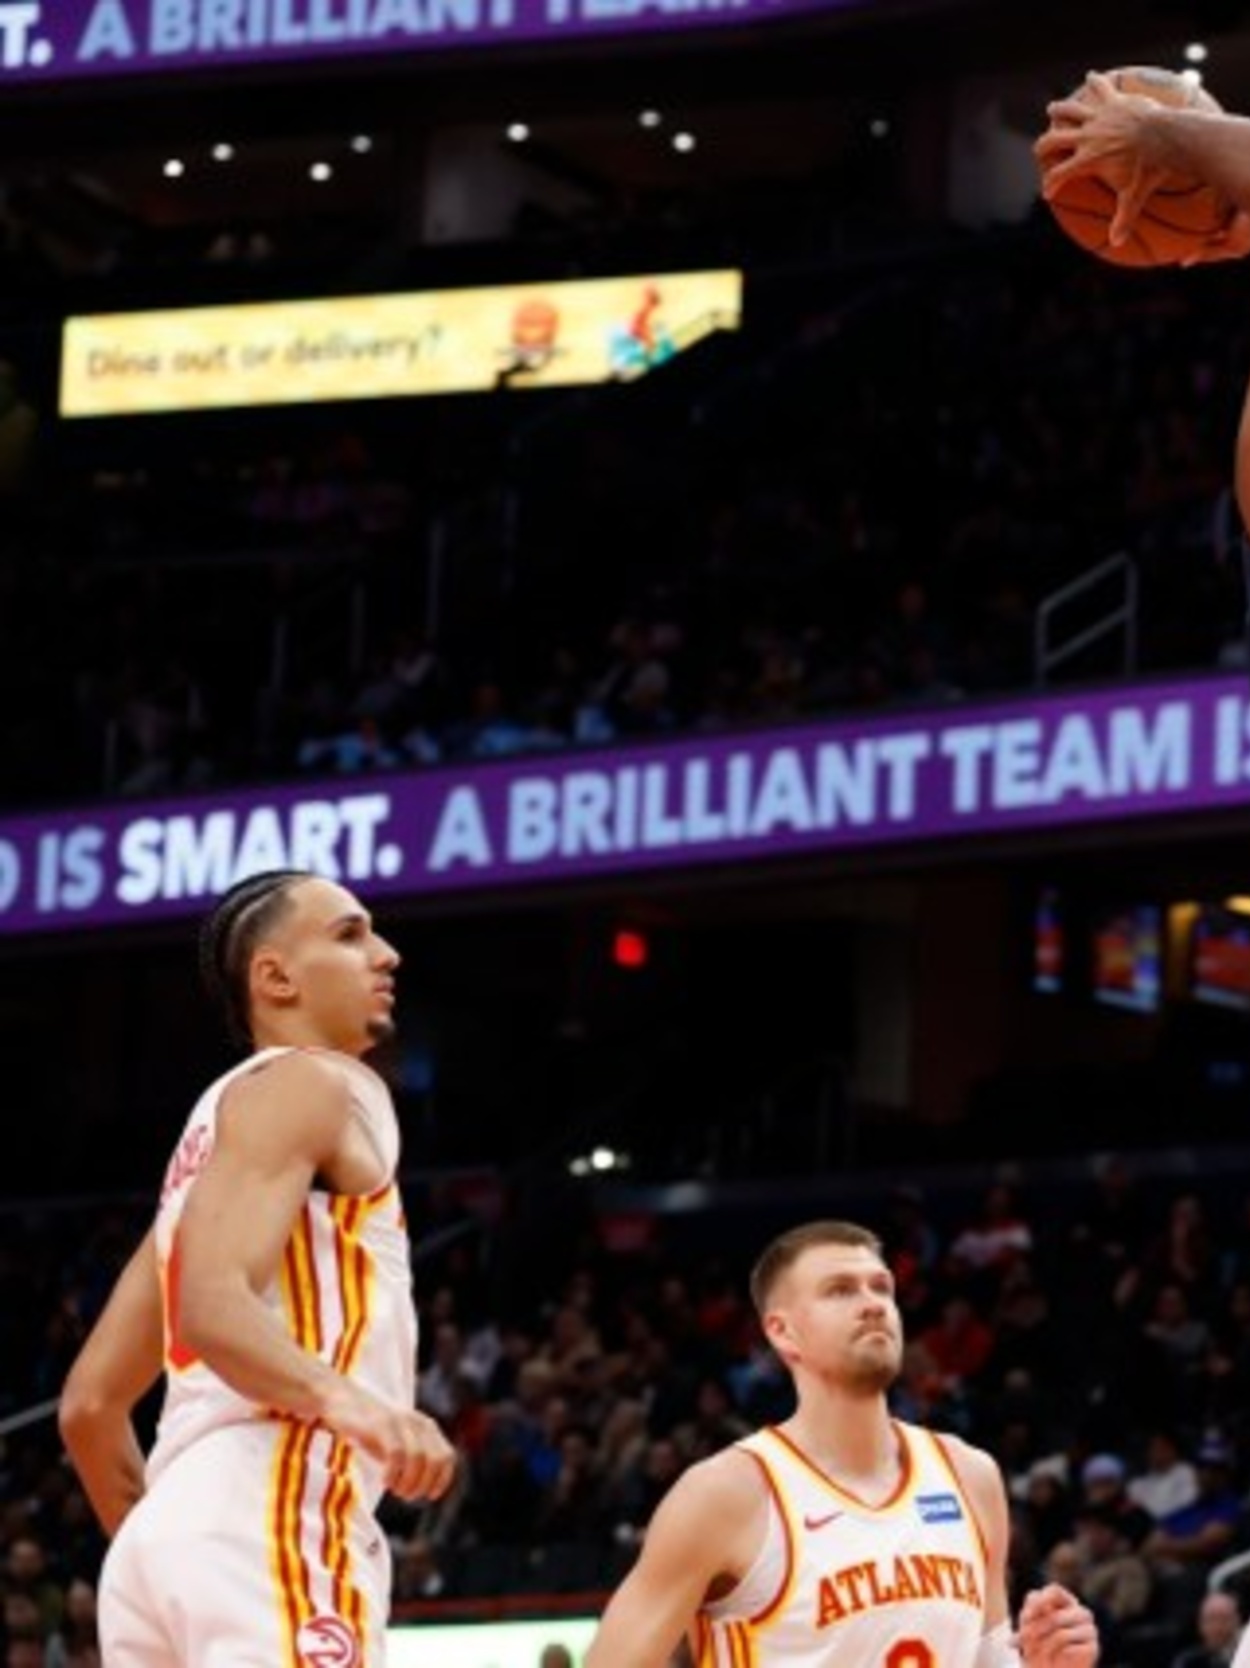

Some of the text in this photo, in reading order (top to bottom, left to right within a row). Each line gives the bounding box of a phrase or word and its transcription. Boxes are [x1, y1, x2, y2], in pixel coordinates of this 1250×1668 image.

[77, 0, 134, 60] A
[87, 323, 444, 379] Dine out or delivery?
[37, 827, 104, 911] IS
[115, 793, 403, 904] SMART.
[427, 786, 492, 871] A
[507, 732, 930, 862] BRILLIANT
[940, 701, 1192, 813] TEAM
[815, 1553, 982, 1630] ATLANTA
